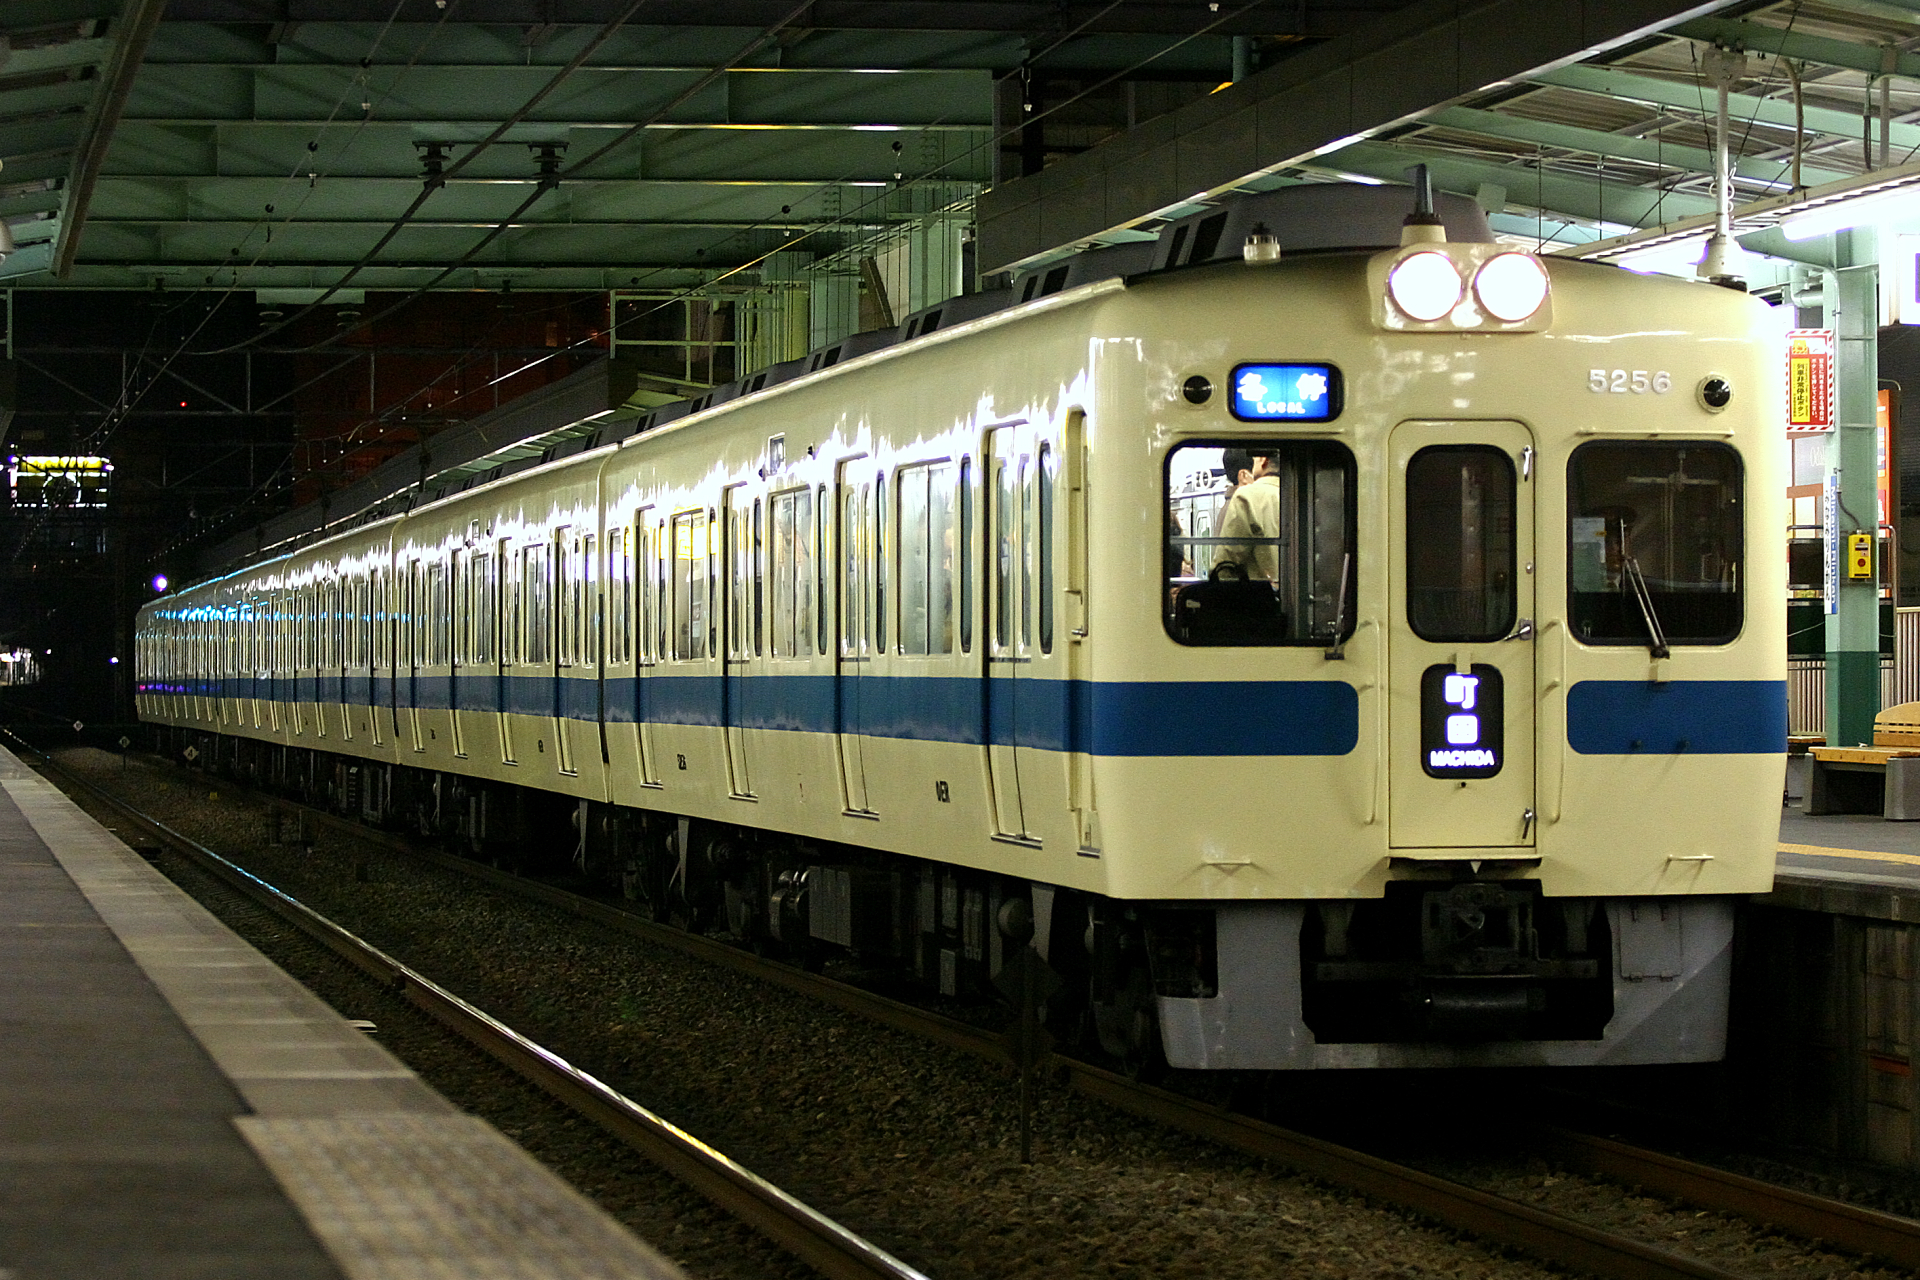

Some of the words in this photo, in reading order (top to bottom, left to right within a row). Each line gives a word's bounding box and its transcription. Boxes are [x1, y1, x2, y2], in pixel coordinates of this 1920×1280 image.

[1588, 369, 1671, 394] 5256
[1256, 402, 1306, 414] LOCAL
[1444, 674, 1479, 744] 町田
[1430, 750, 1495, 766] MACHIDA
